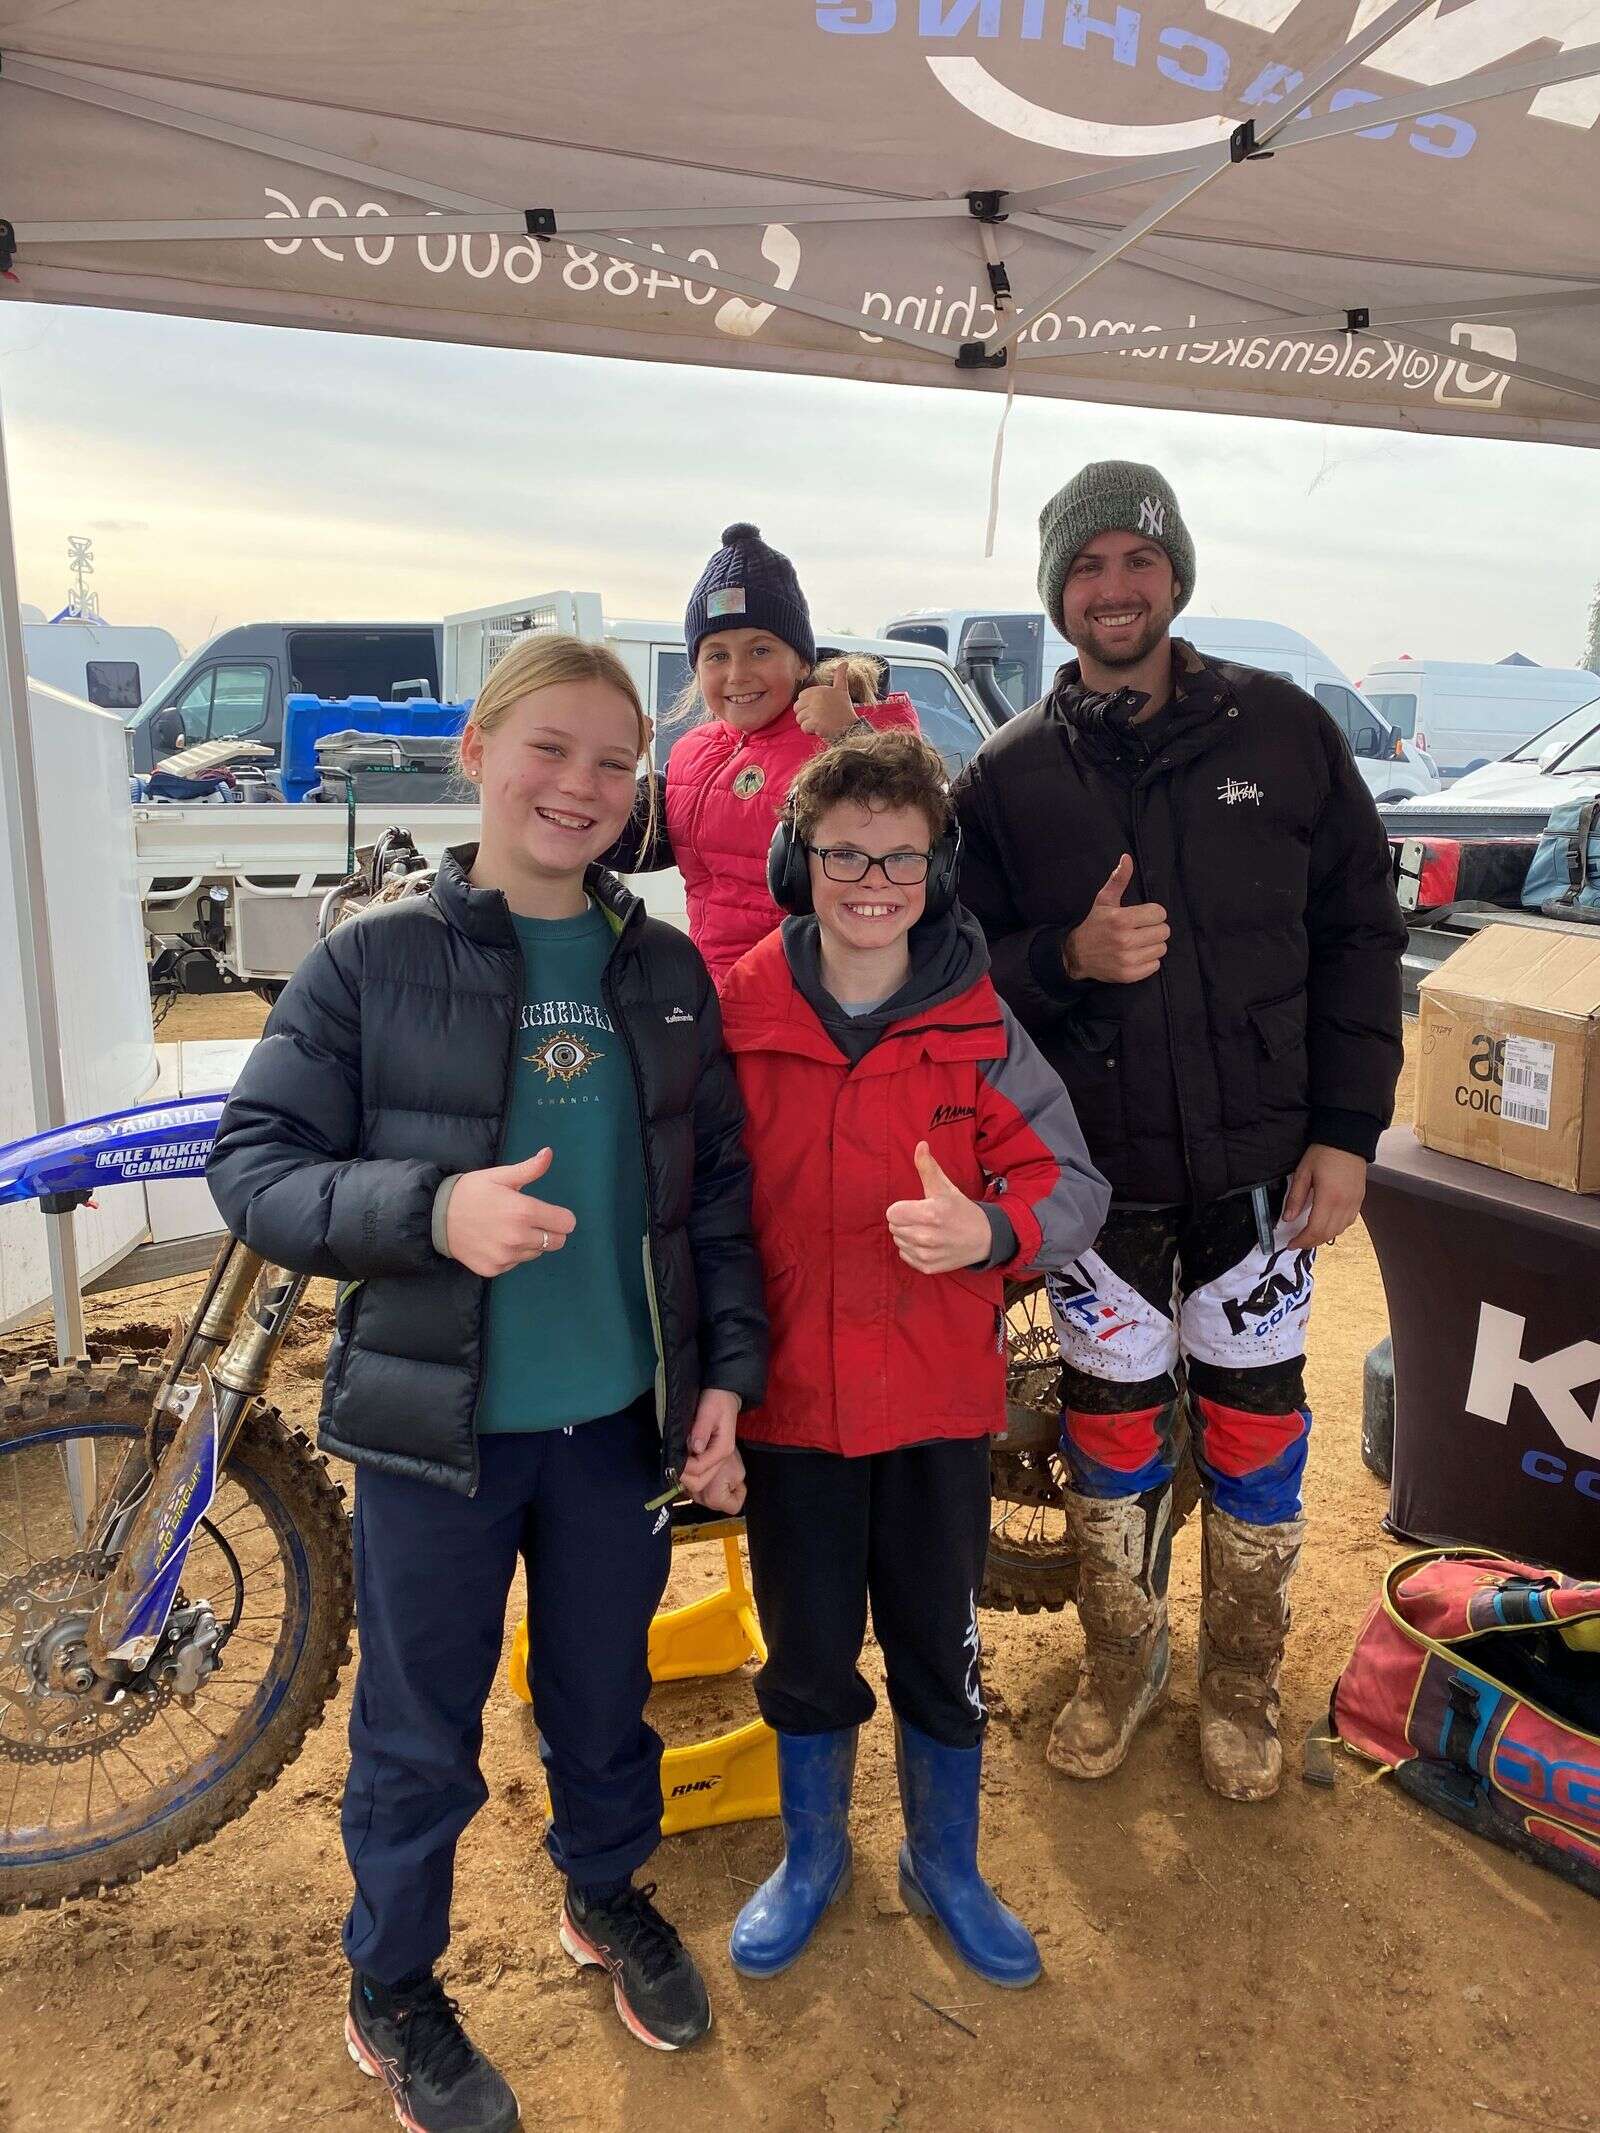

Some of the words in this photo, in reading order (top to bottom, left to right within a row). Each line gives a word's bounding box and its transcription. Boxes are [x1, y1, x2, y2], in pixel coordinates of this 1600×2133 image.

[106, 1108, 209, 1137] YAMAHA
[99, 1149, 144, 1167] KALE
[150, 1141, 215, 1160] MAKEH
[124, 1154, 208, 1176] COACHIN
